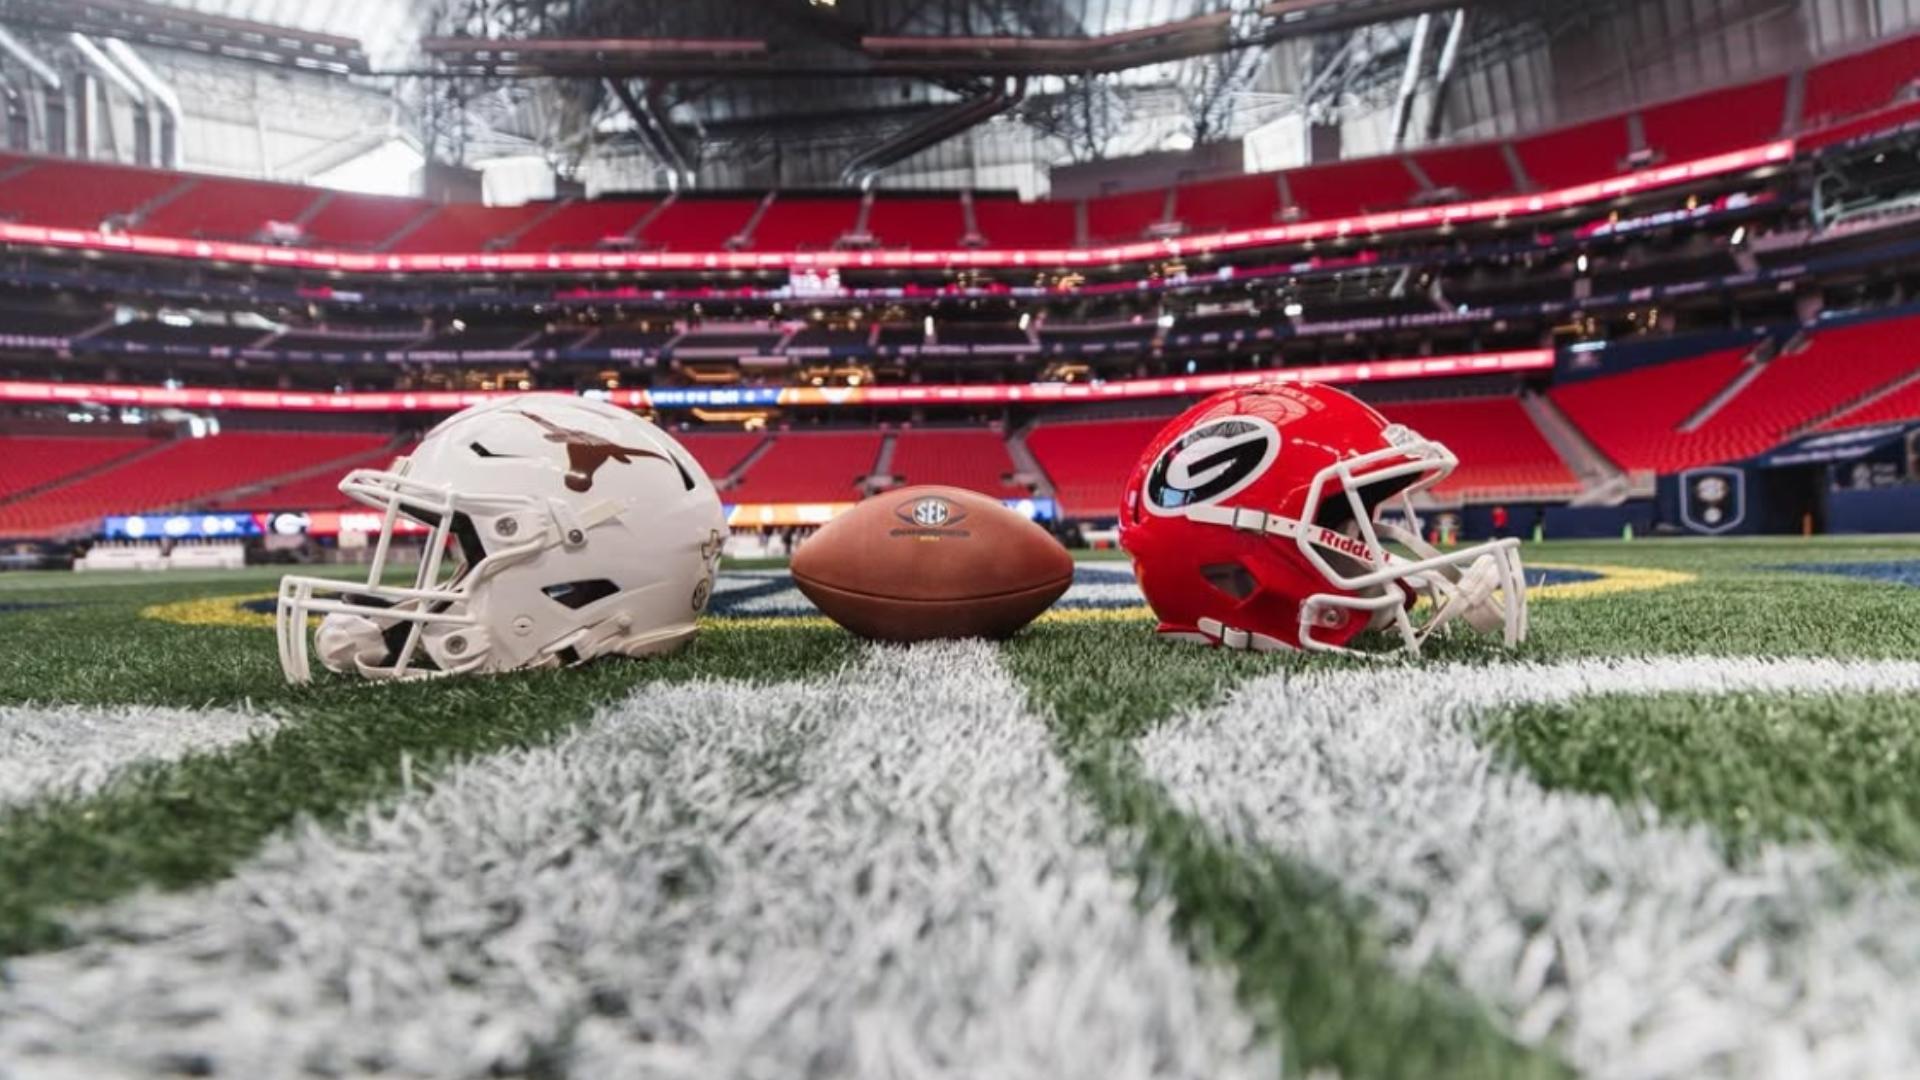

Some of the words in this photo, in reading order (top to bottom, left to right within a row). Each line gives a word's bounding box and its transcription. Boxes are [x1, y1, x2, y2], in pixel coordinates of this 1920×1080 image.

[1147, 420, 1270, 509] G
[916, 500, 946, 524] SEC
[1319, 528, 1390, 563] Riddel
